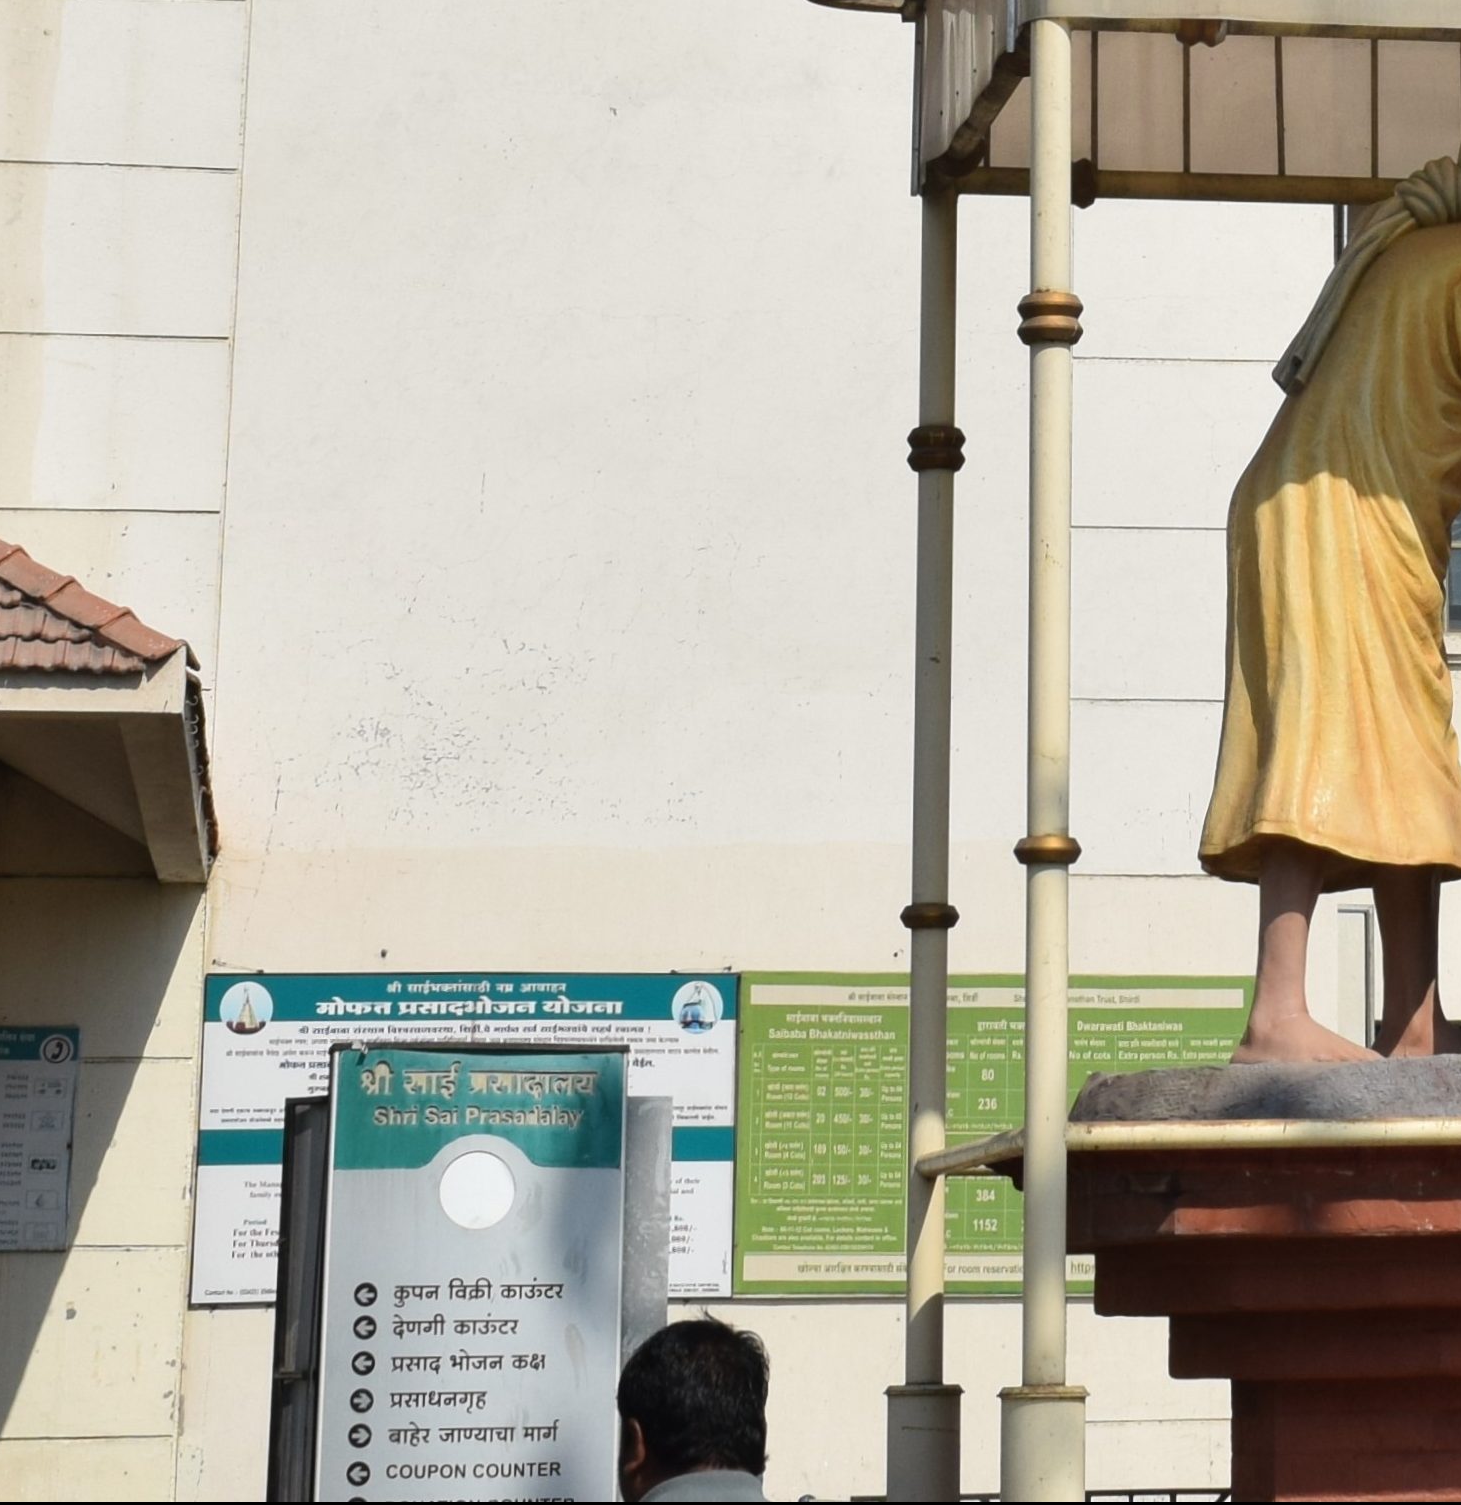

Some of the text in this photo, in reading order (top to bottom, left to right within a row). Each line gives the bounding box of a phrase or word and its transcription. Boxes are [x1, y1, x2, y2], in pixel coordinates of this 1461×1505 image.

[520, 981, 567, 993] आवाहन
[315, 995, 623, 1016] मोफत प्रसादभोजन योजना
[1077, 1020, 1183, 1031] Dwarawati Bhaktaniwas
[769, 1028, 807, 1039] Saibaba
[1068, 1050, 1078, 1060] No
[1079, 1050, 1091, 1060] of
[1118, 1050, 1138, 1060] Extra
[360, 1060, 598, 1099] श्री साई प्रसादालय
[981, 1069, 995, 1081] 80
[978, 1097, 998, 1110] 236
[374, 1105, 585, 1129] Shri Sai Prasadalay
[976, 1189, 996, 1201] 384
[973, 1219, 998, 1231] 1152
[958, 1264, 981, 1273] room
[393, 1277, 564, 1308] कुपन विक्री काऊंटर
[392, 1313, 519, 1339] देणगी काऊंटर
[391, 1349, 546, 1374] प्रसाद भोजन कक्ष
[389, 1390, 487, 1414] प्रसाधनगृह
[388, 1419, 560, 1447] बाहेर जाण्याचा मार्ग
[386, 1461, 562, 1480] COUPON COUNTER
